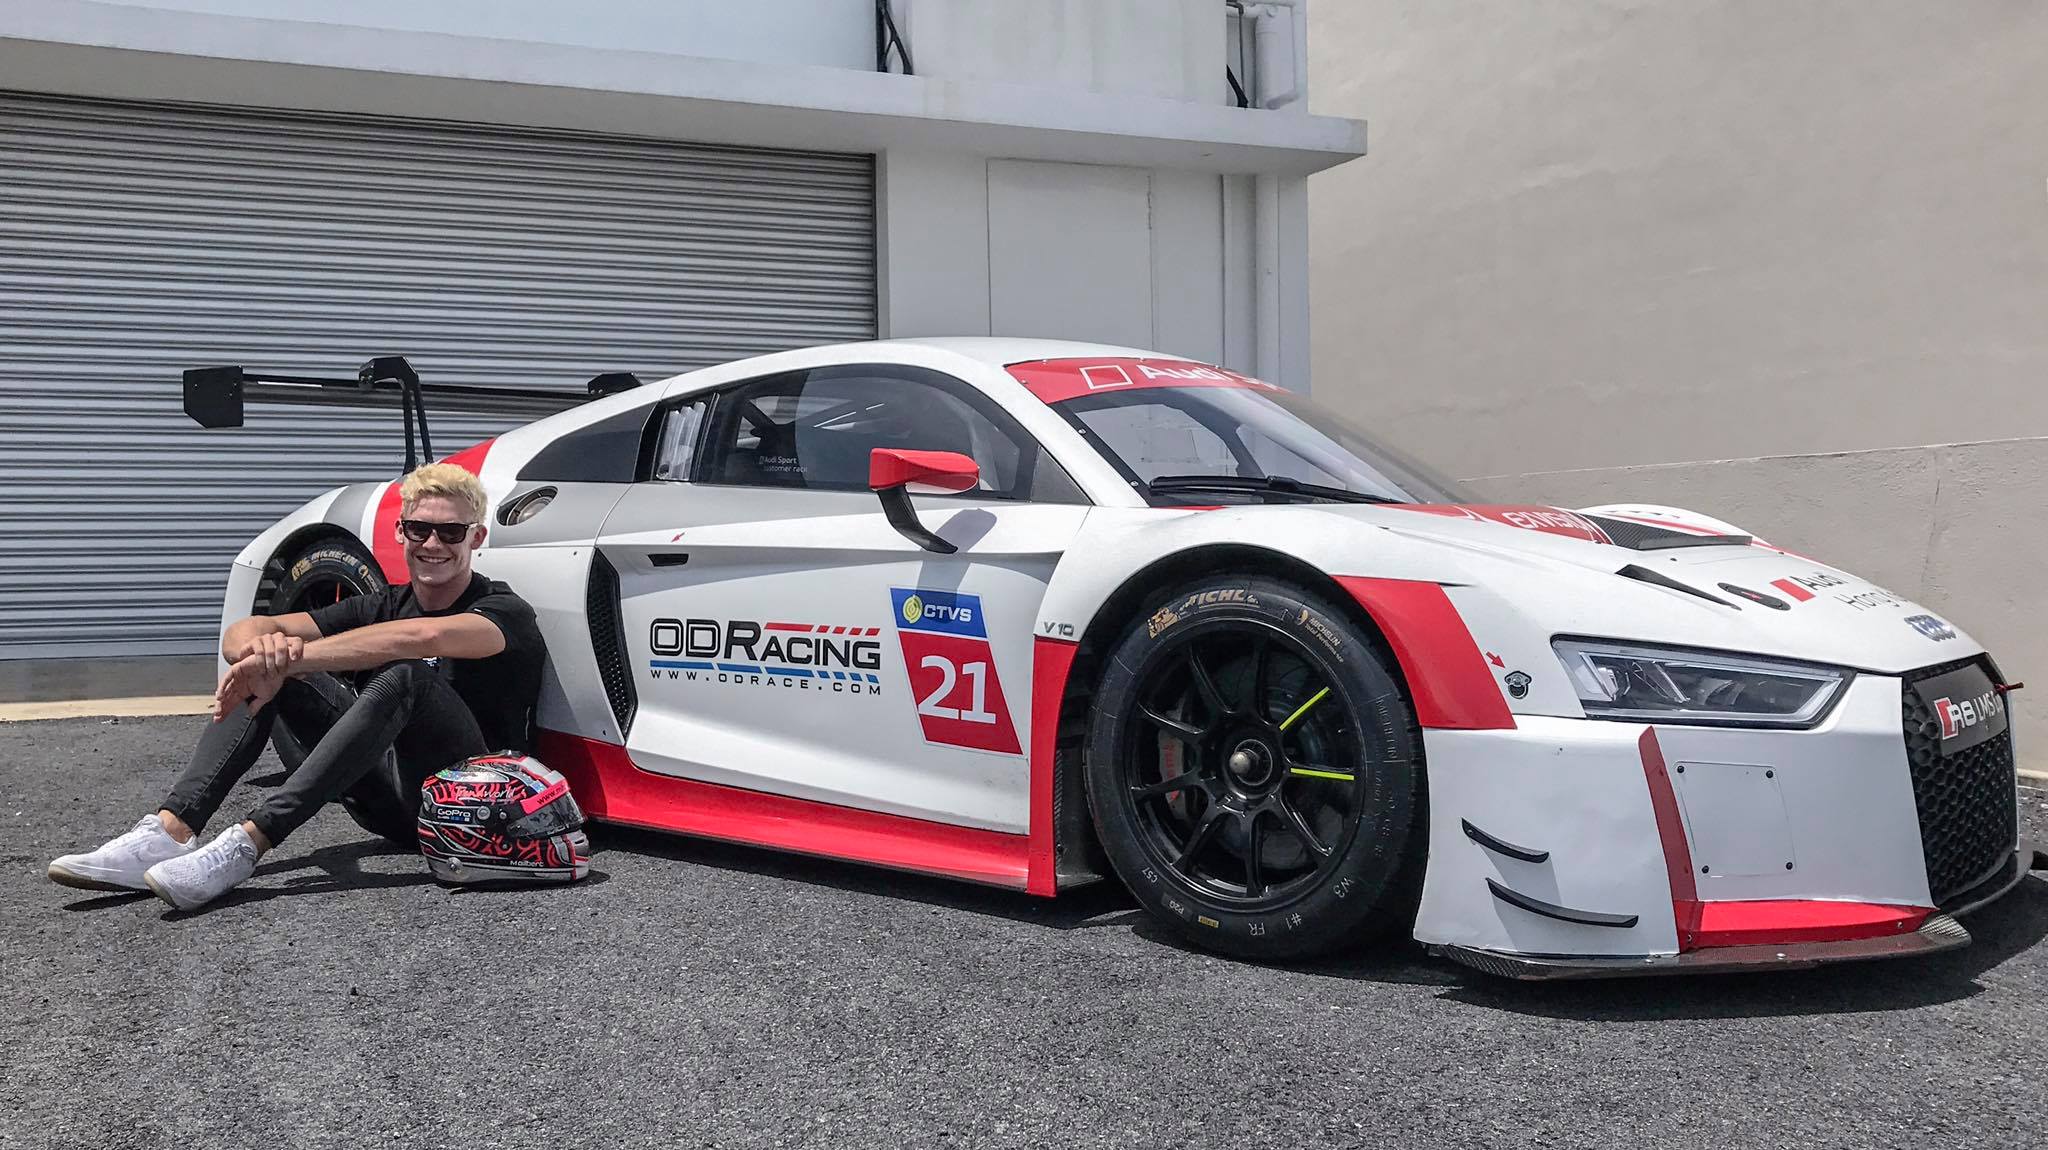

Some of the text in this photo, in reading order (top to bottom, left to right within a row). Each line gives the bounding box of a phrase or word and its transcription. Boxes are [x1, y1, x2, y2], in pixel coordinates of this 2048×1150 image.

[1136, 364, 1234, 382] Audi
[777, 456, 797, 465] Sport
[312, 550, 358, 567] MICHELIN
[1789, 571, 1848, 591] Audi
[923, 604, 973, 623] CTVS
[1309, 617, 1342, 647] MICHELIN
[650, 669, 881, 696] WWW.ODRACE.COM
[917, 654, 997, 725] 21
[437, 808, 471, 818] GoPro
[1248, 912, 1303, 937] #1 FR
